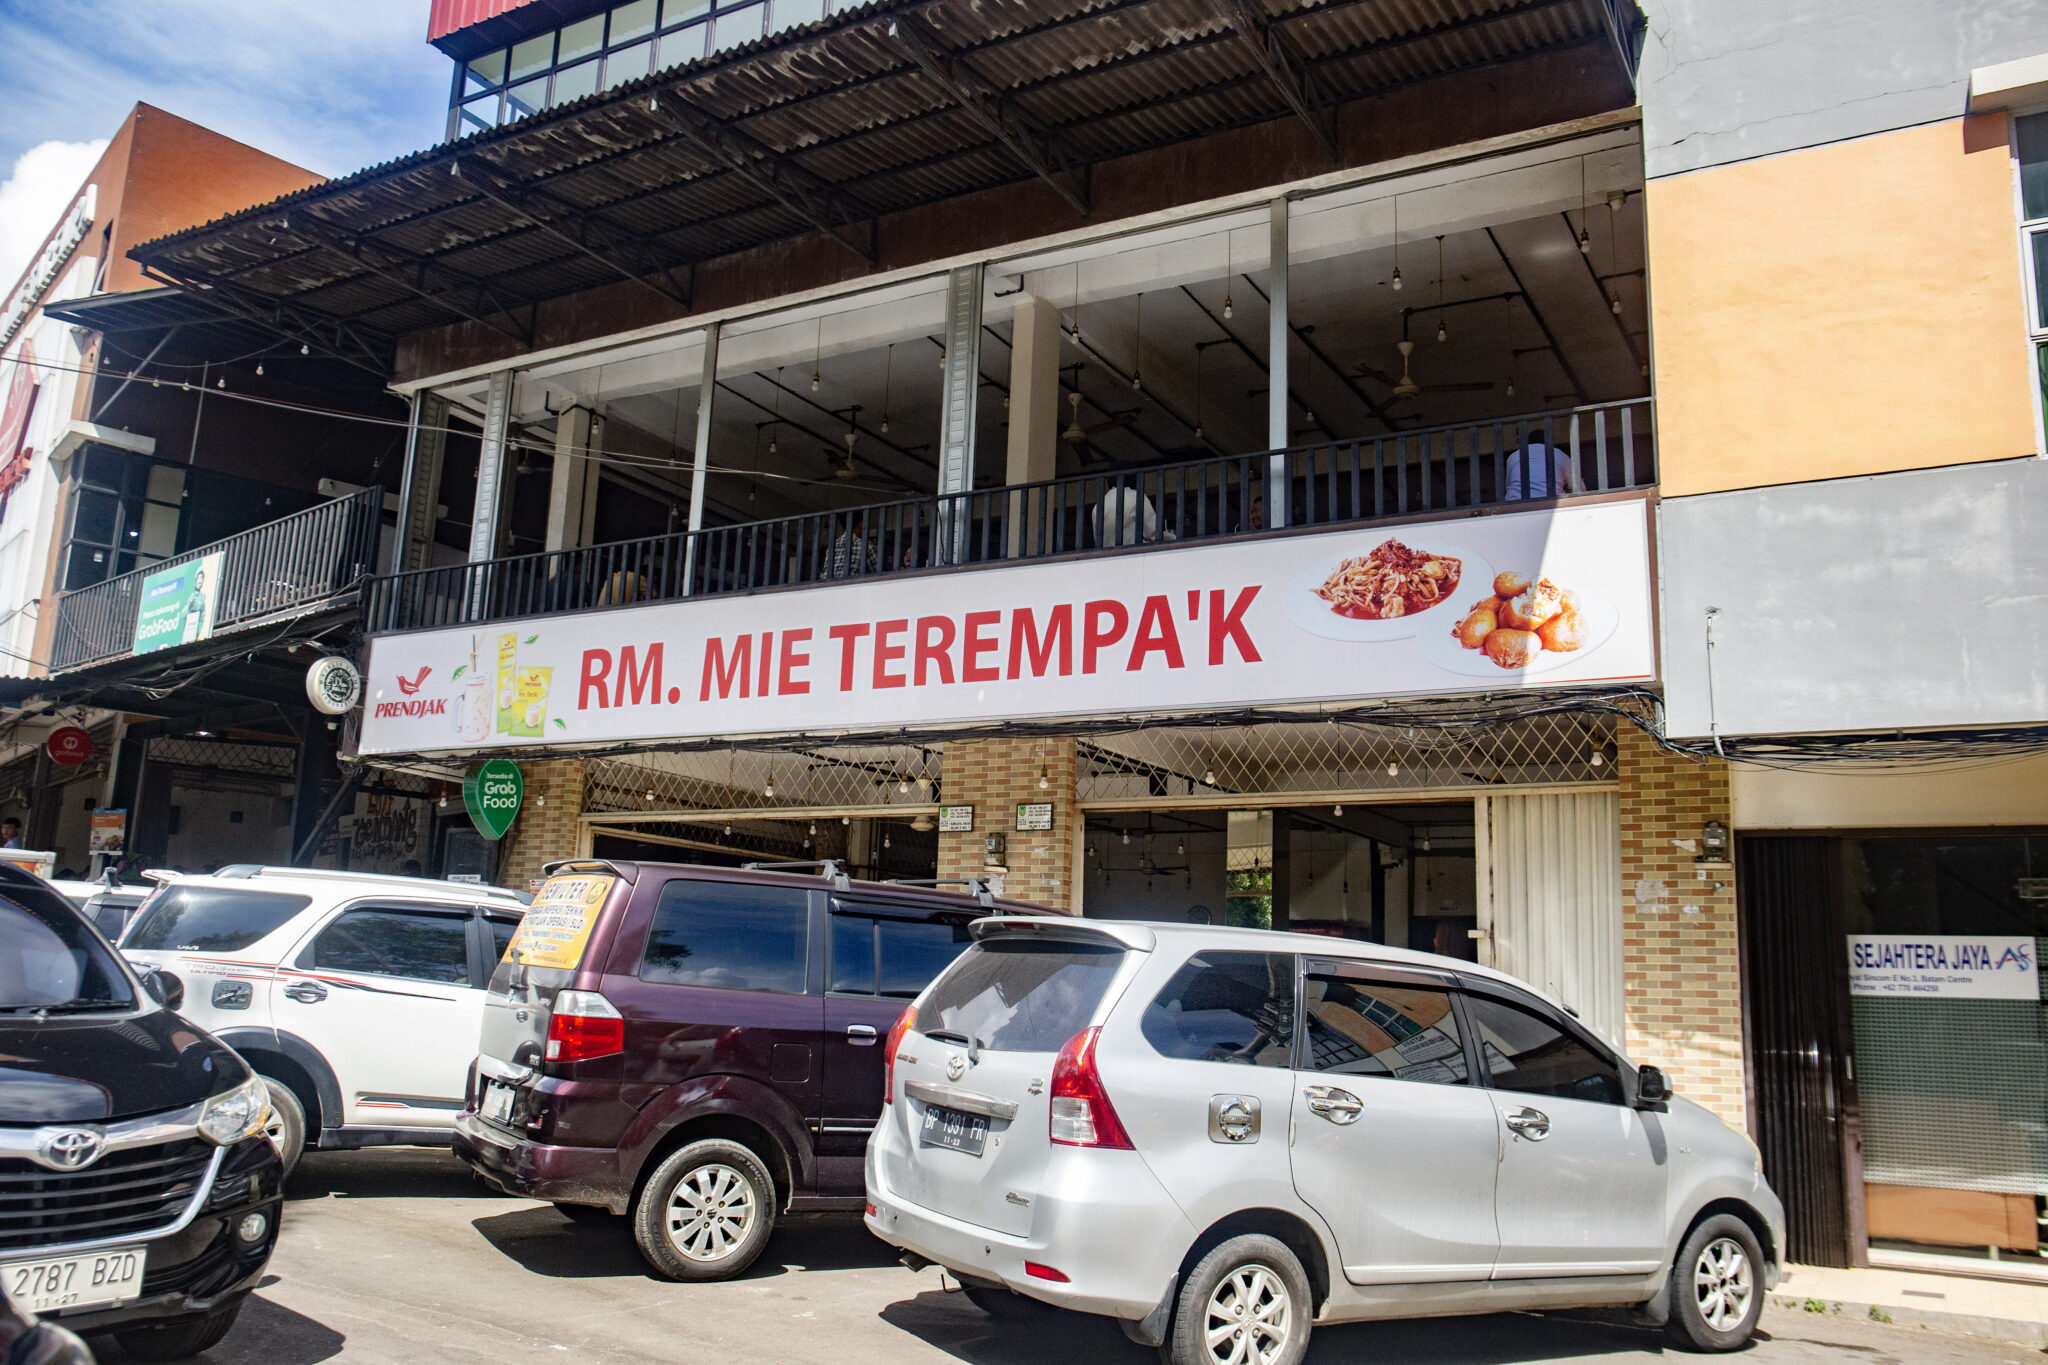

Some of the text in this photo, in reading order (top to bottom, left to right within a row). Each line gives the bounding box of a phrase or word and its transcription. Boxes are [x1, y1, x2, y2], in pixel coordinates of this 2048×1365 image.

[138, 613, 180, 640] GrabFood
[578, 585, 1263, 710] RM. MIE TEREMPA'K
[375, 698, 448, 719] PRENDJAK
[484, 781, 516, 795] Grab
[483, 795, 517, 809] Food
[1855, 943, 1949, 969] SEJAHTERA
[1951, 945, 1992, 970] JAYA
[1853, 983, 1876, 991] Phone
[924, 1108, 985, 1141] BP 1391 FR
[13, 1254, 136, 1296] 2787 BZD
